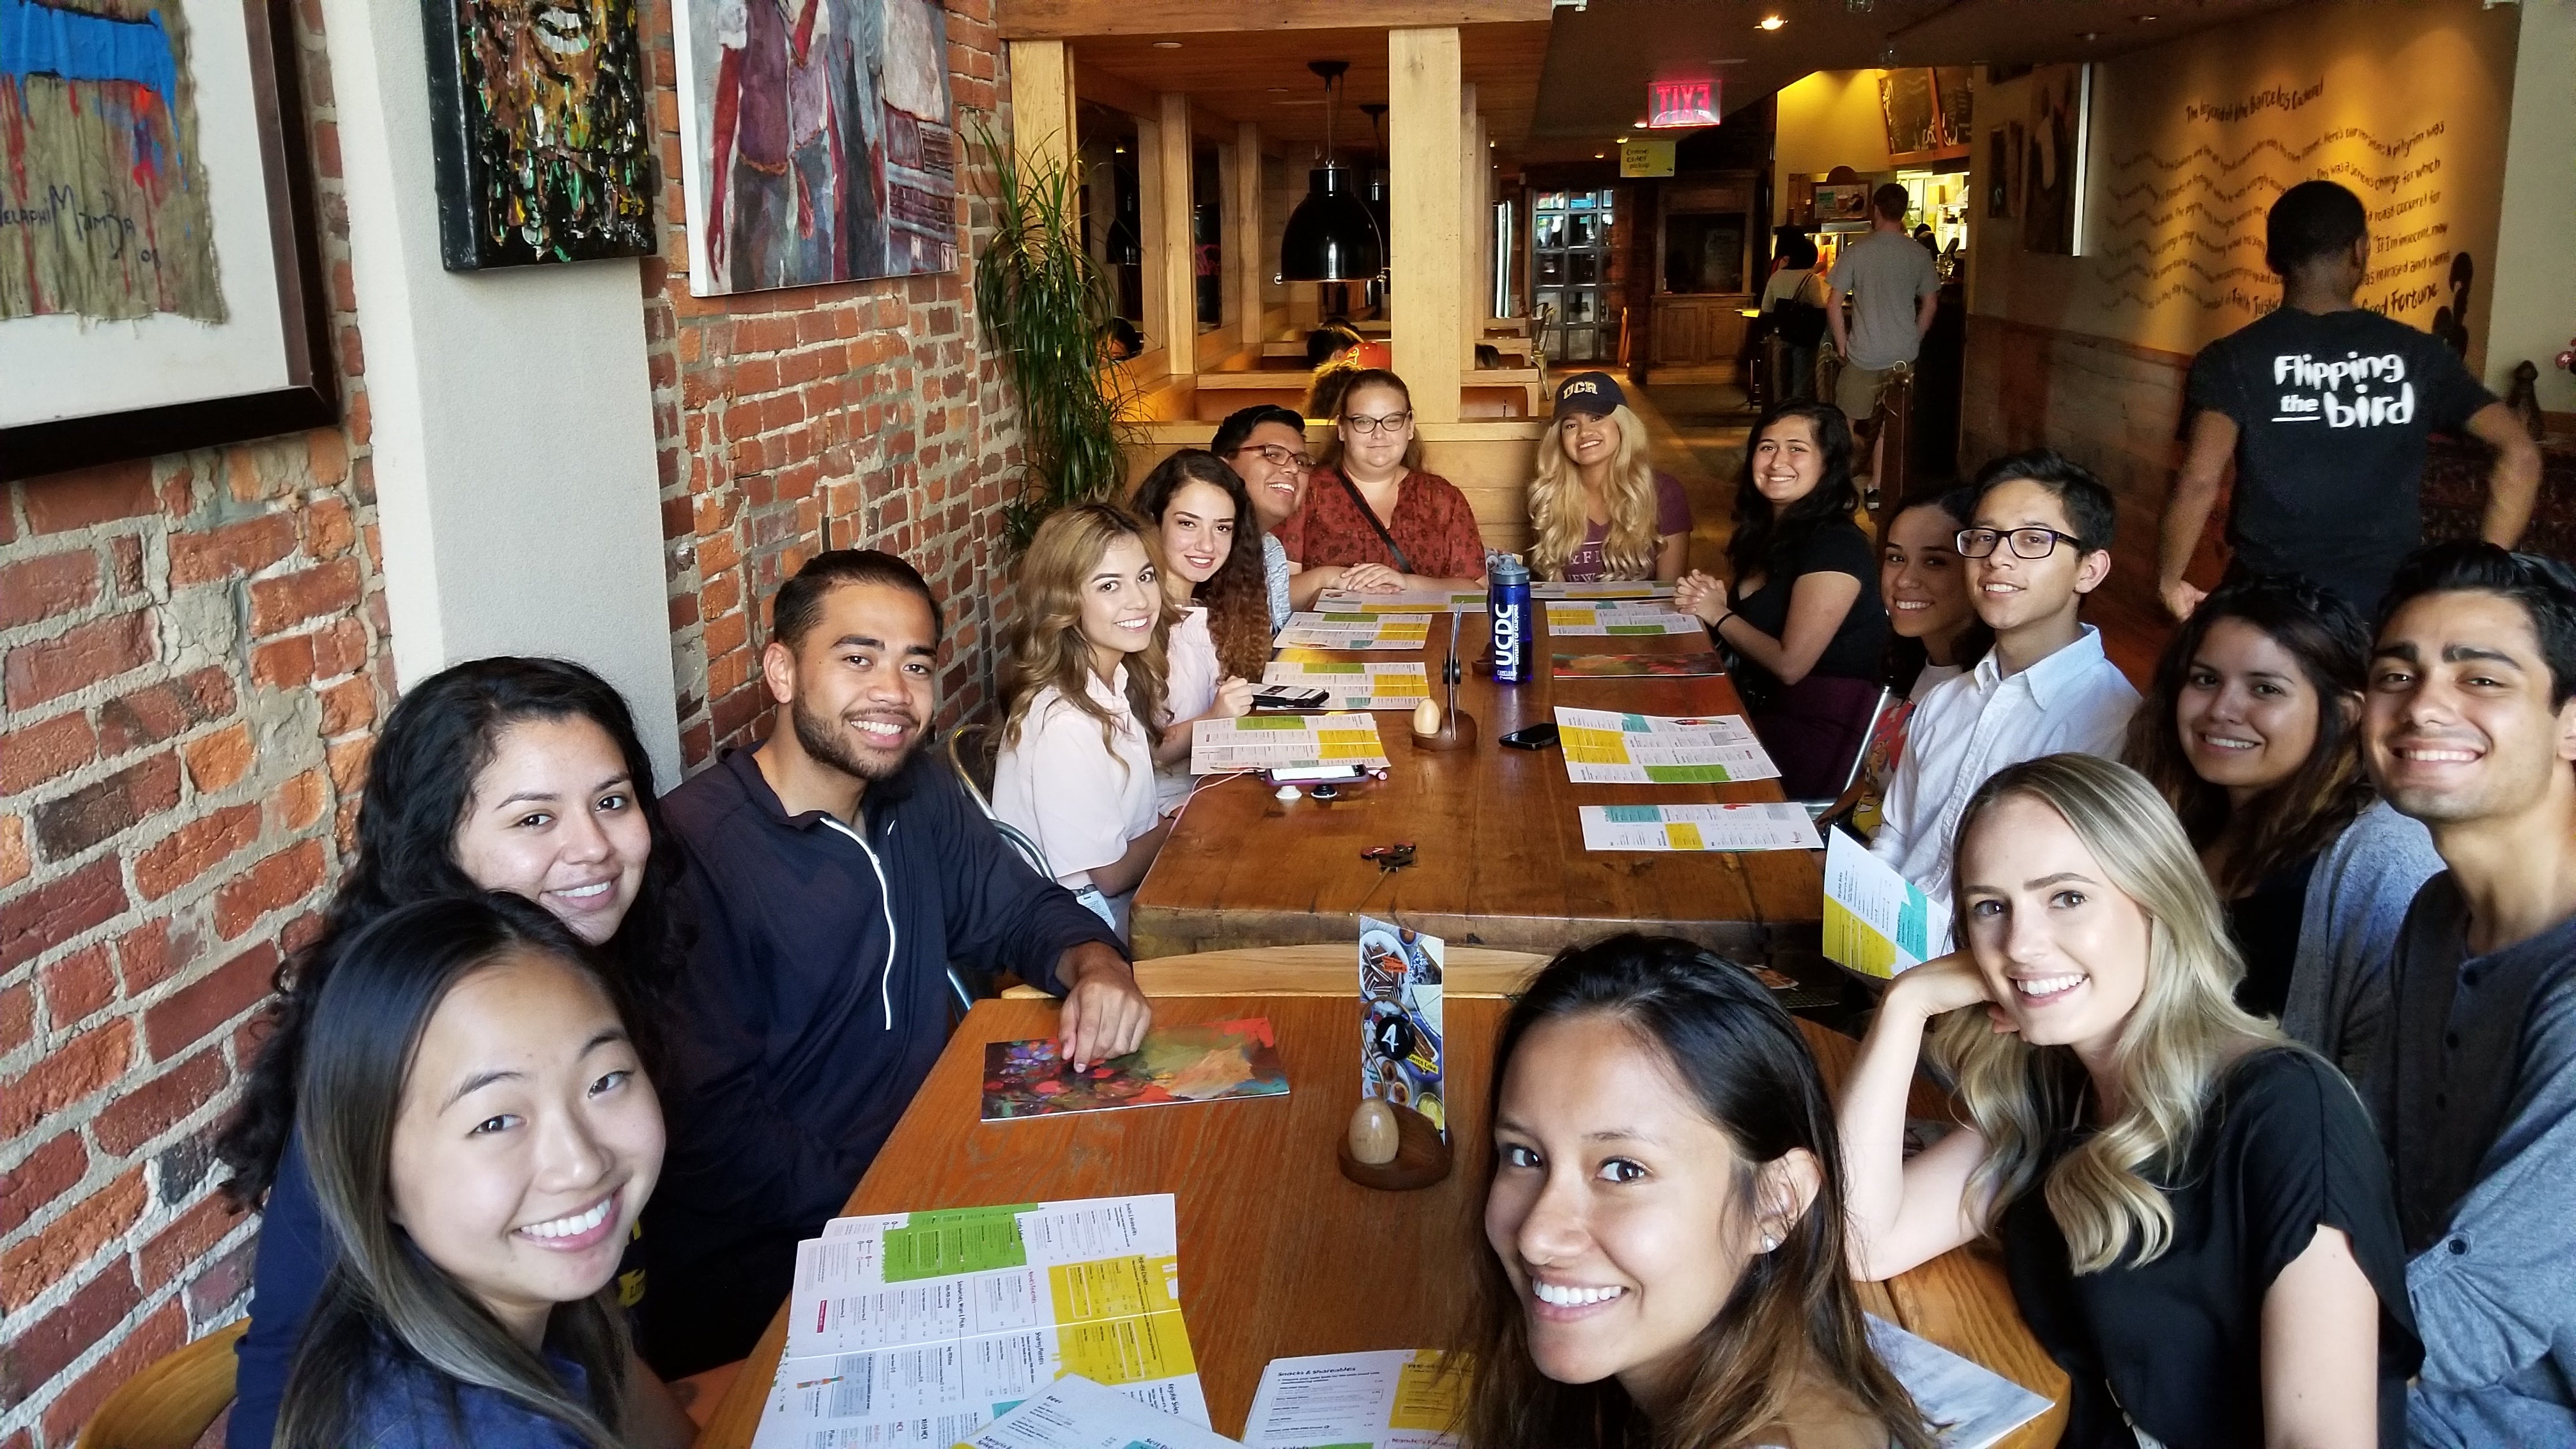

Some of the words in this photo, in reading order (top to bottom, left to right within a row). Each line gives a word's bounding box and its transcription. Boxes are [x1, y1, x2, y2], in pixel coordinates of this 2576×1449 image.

[0, 208, 51, 227] ELAPHI
[2274, 351, 2405, 392] Flipping
[1563, 381, 1598, 400] UCR
[2280, 394, 2319, 413] the
[2323, 381, 2415, 429] bird
[1494, 603, 1513, 666] UCDC
[1381, 1023, 1399, 1053] 4
